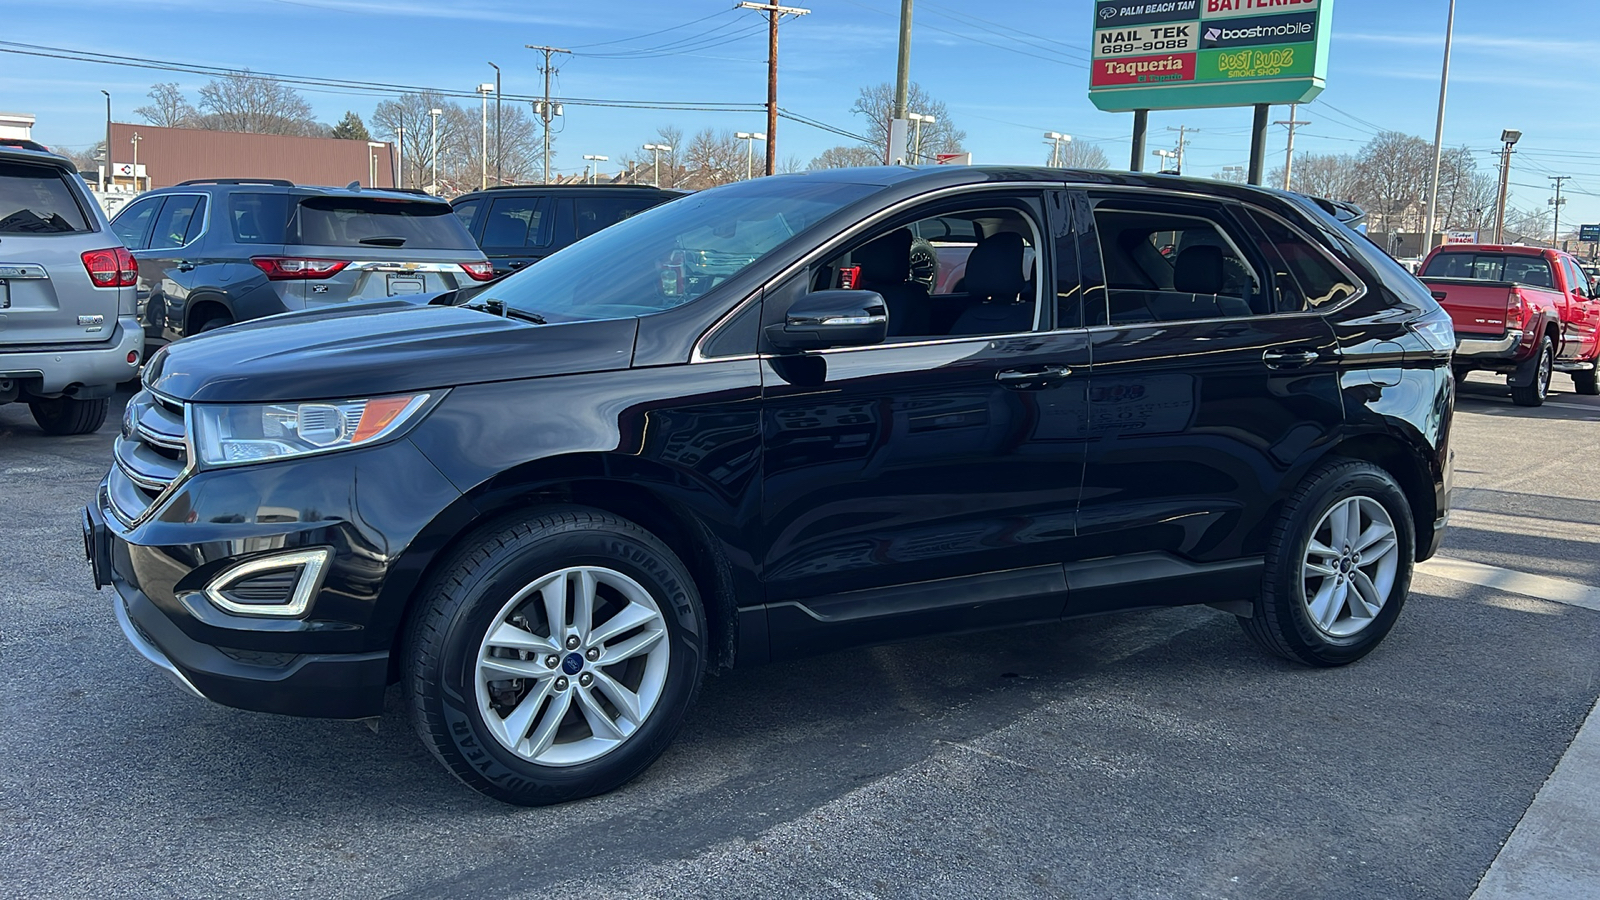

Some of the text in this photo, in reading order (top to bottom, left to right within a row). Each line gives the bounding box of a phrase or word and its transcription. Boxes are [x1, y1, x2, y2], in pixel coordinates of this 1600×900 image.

[1119, 0, 1196, 17] PALM BEACH TAN
[1207, 0, 1313, 13] BATTE
[1101, 25, 1190, 44] NAIL TEK
[1222, 22, 1312, 40] boostmobile
[1101, 39, 1188, 54] 689-9088
[1253, 48, 1294, 70] BUDZ
[1228, 67, 1281, 78] SMOKE SHOP
